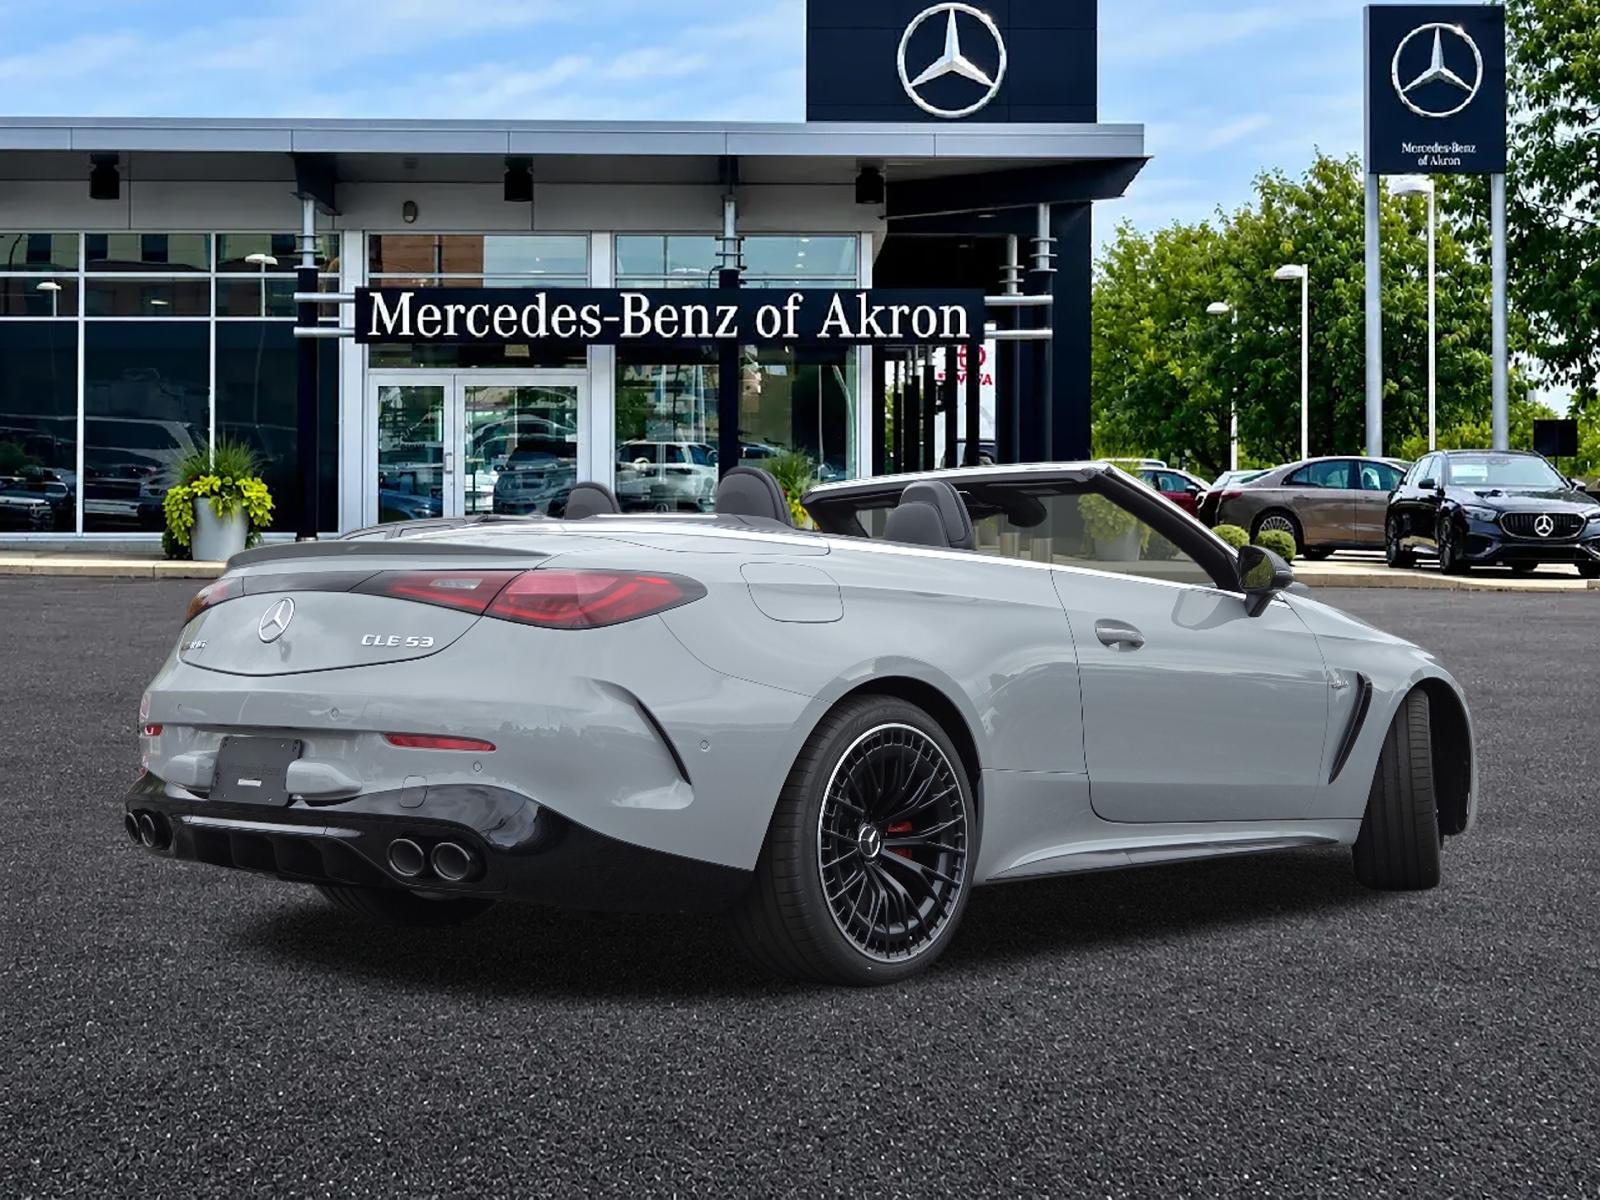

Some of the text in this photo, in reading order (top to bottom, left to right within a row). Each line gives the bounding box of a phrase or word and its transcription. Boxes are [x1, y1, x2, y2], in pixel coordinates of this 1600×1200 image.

[1401, 141, 1476, 153] Mercedes-Benz
[1417, 154, 1461, 166] of Akron
[366, 290, 971, 339] Mercedes-Benz of Akron
[361, 634, 435, 648] CLE 53
